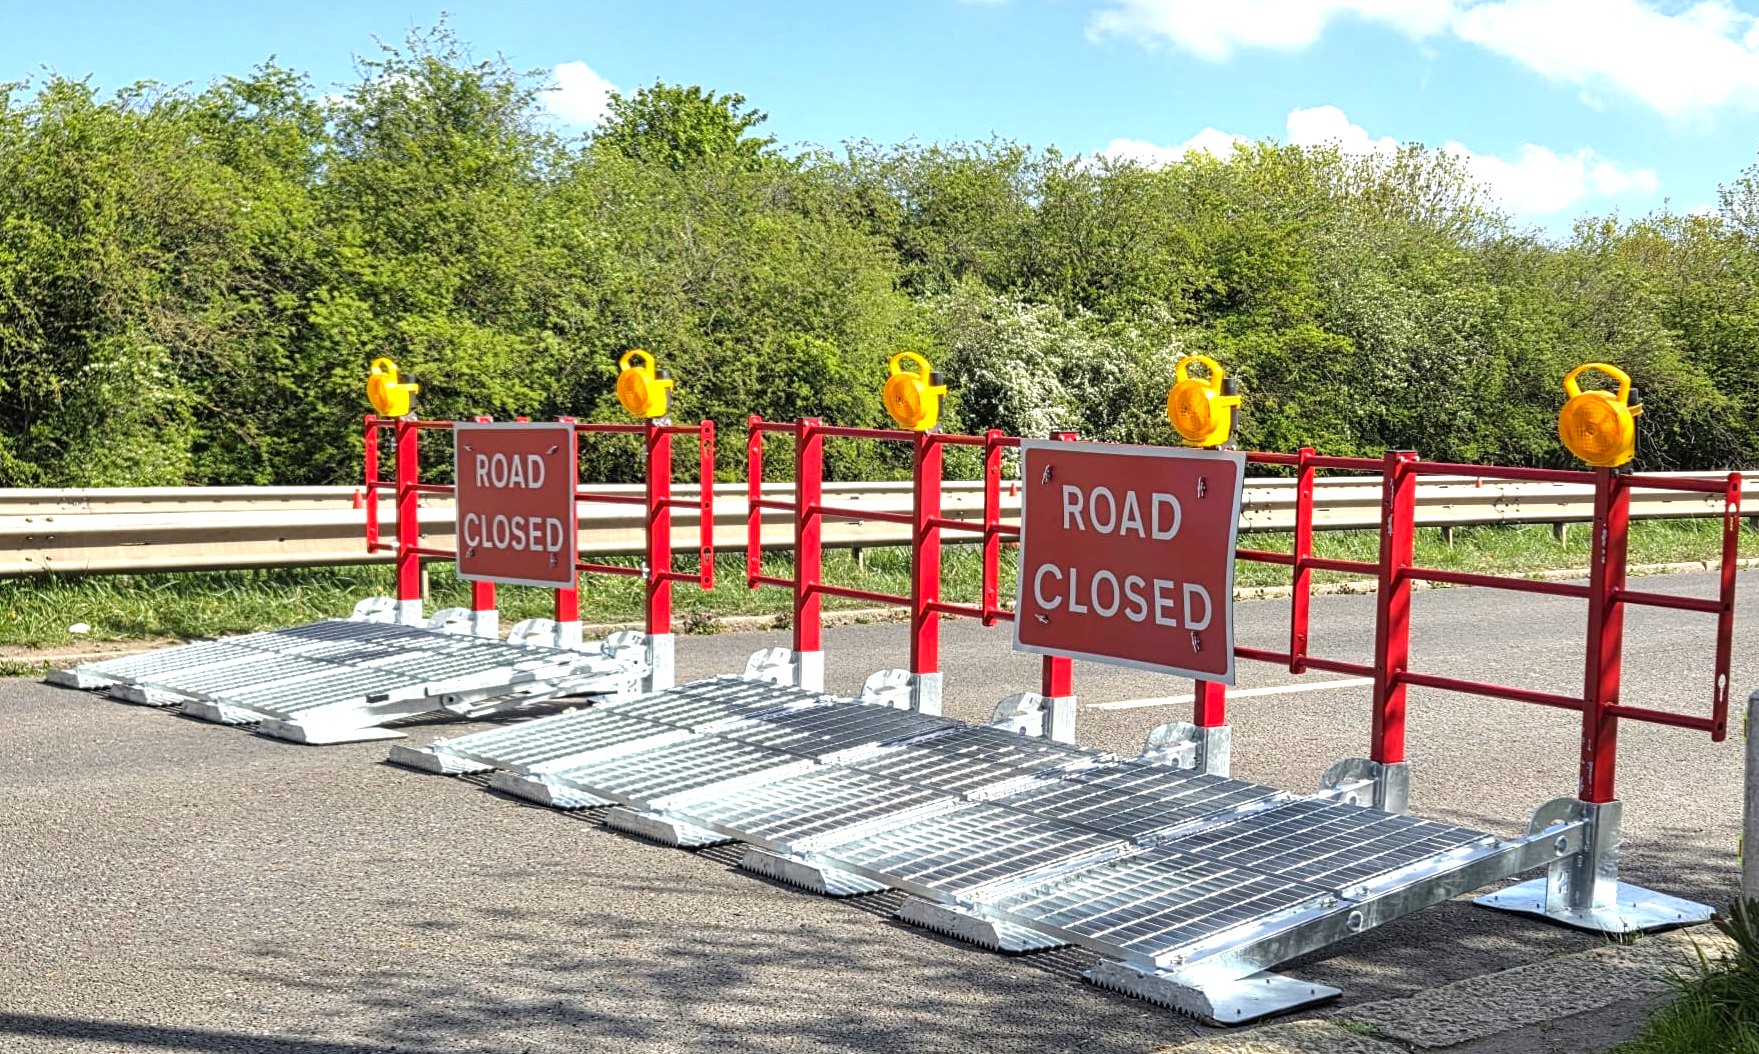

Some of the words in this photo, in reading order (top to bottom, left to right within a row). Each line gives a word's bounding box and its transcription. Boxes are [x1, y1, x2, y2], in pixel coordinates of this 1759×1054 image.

[475, 453, 545, 489] ROAD
[463, 512, 564, 552] CLOSED
[1062, 484, 1182, 541] ROAD
[1034, 563, 1212, 631] CLOSED
